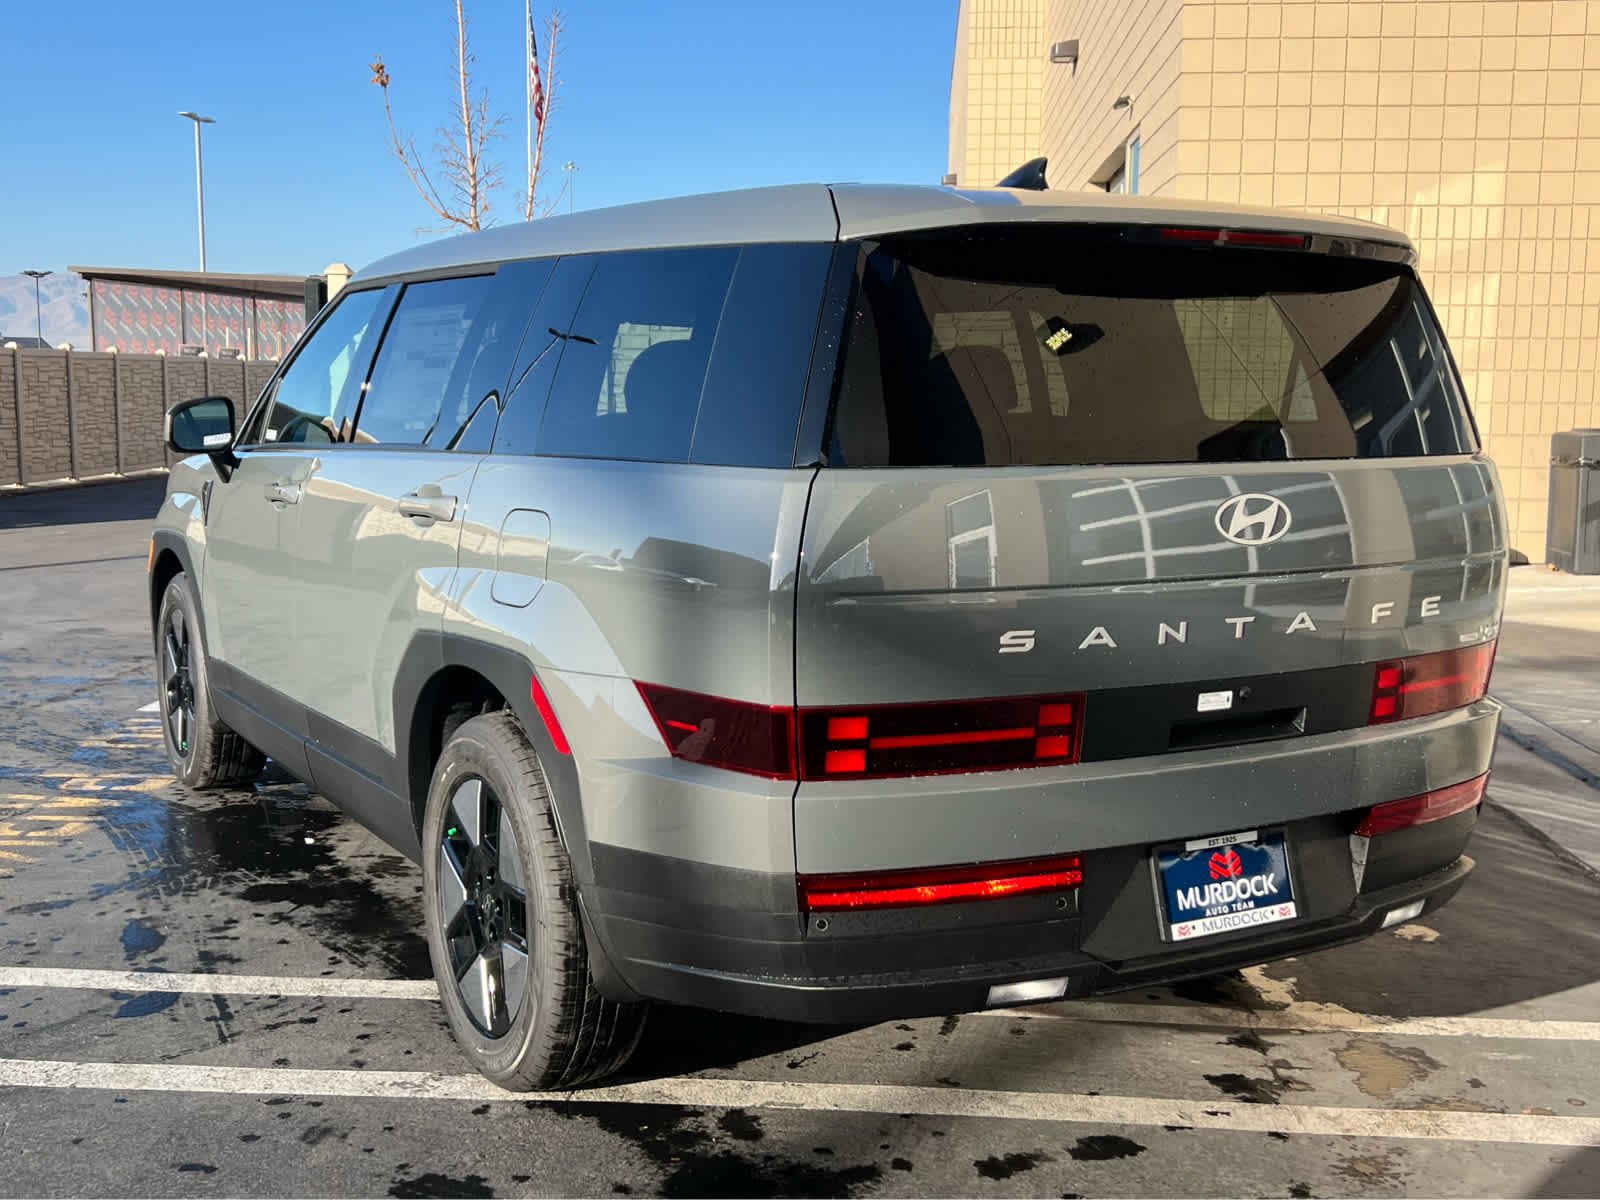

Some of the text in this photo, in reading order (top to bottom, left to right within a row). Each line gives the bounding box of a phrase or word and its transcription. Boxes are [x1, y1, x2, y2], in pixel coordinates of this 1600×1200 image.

[999, 596, 1441, 653] SANTA FE
[1176, 873, 1278, 911] MURDOCK
[1202, 909, 1270, 932] MURDOCK
[1205, 901, 1255, 917] AUTO TEAM
